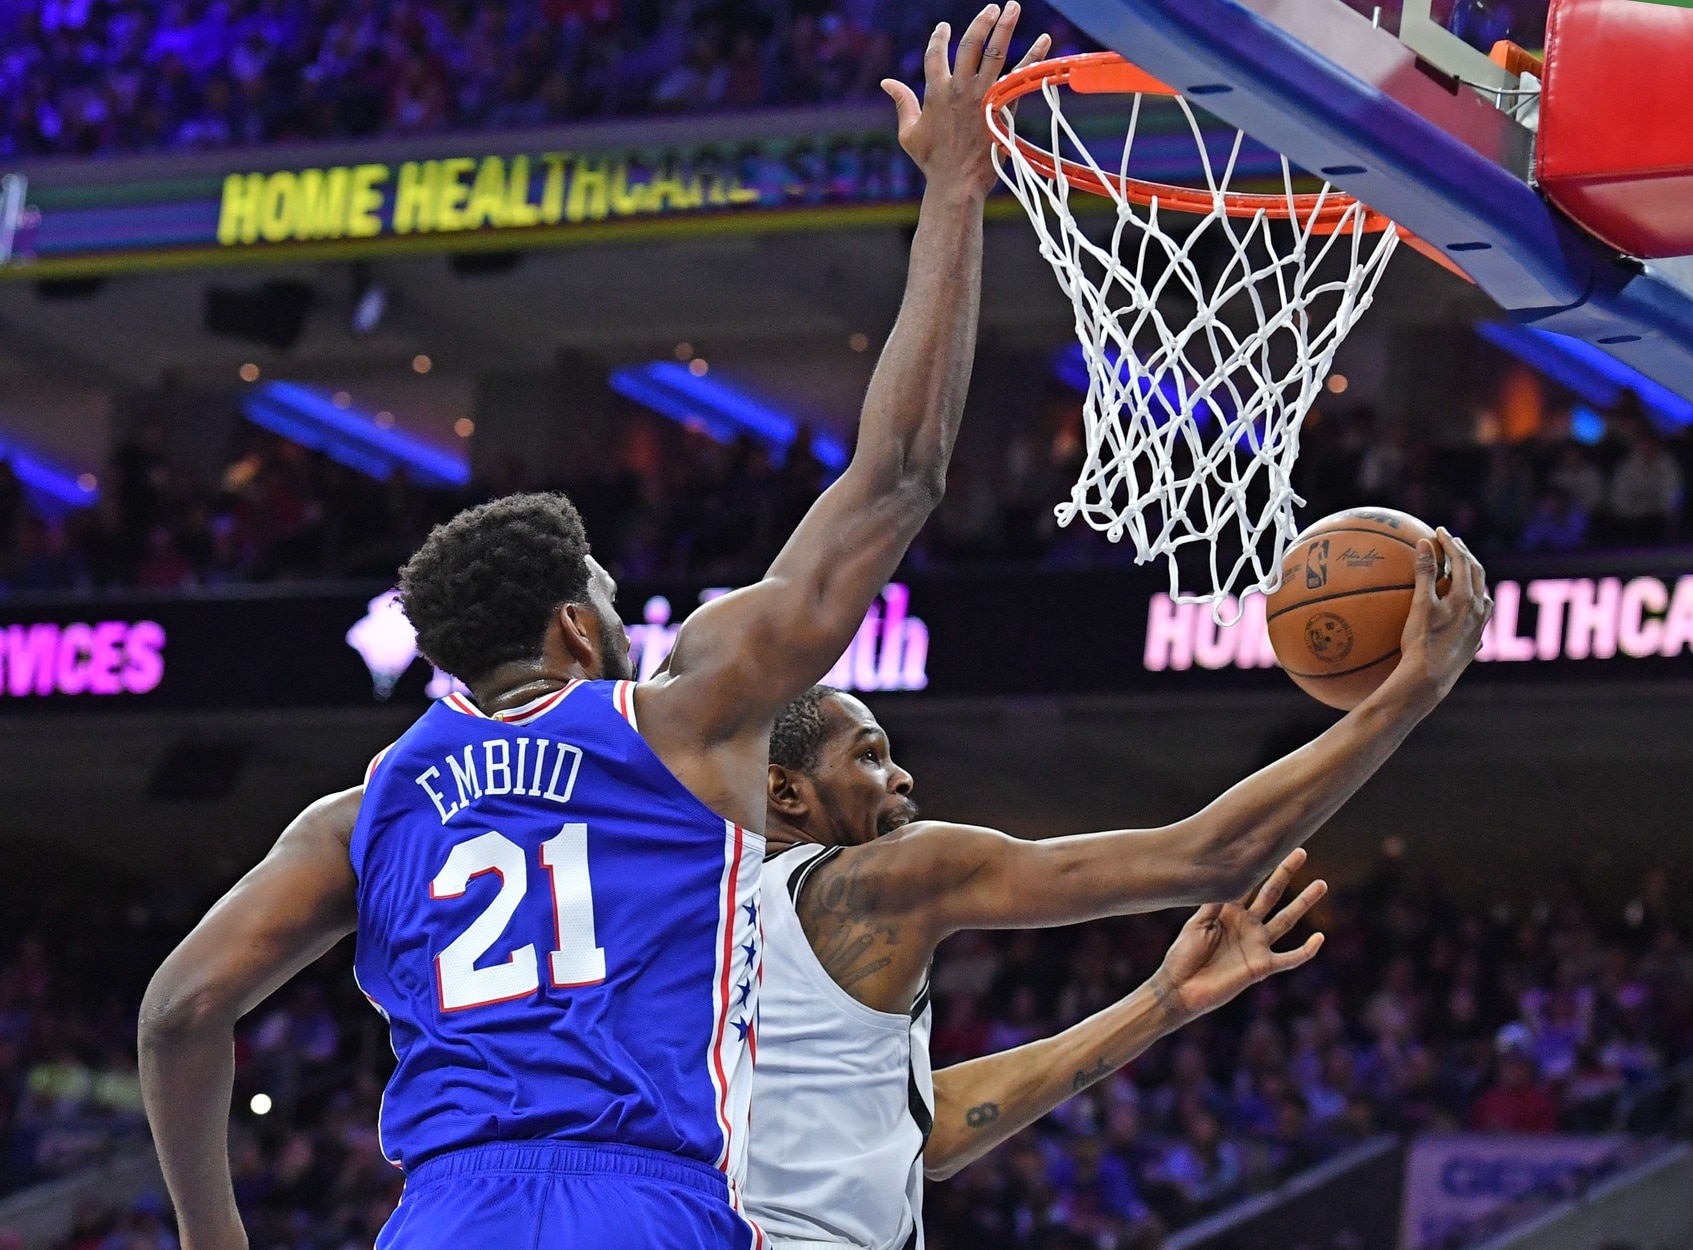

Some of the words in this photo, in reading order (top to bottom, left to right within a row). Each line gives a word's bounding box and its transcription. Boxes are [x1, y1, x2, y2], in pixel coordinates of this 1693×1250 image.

[217, 163, 389, 246] HOME
[0, 620, 167, 697] VICES
[1143, 591, 1284, 671] HOM
[415, 737, 583, 825] EMBIID
[429, 823, 606, 1012] 21
